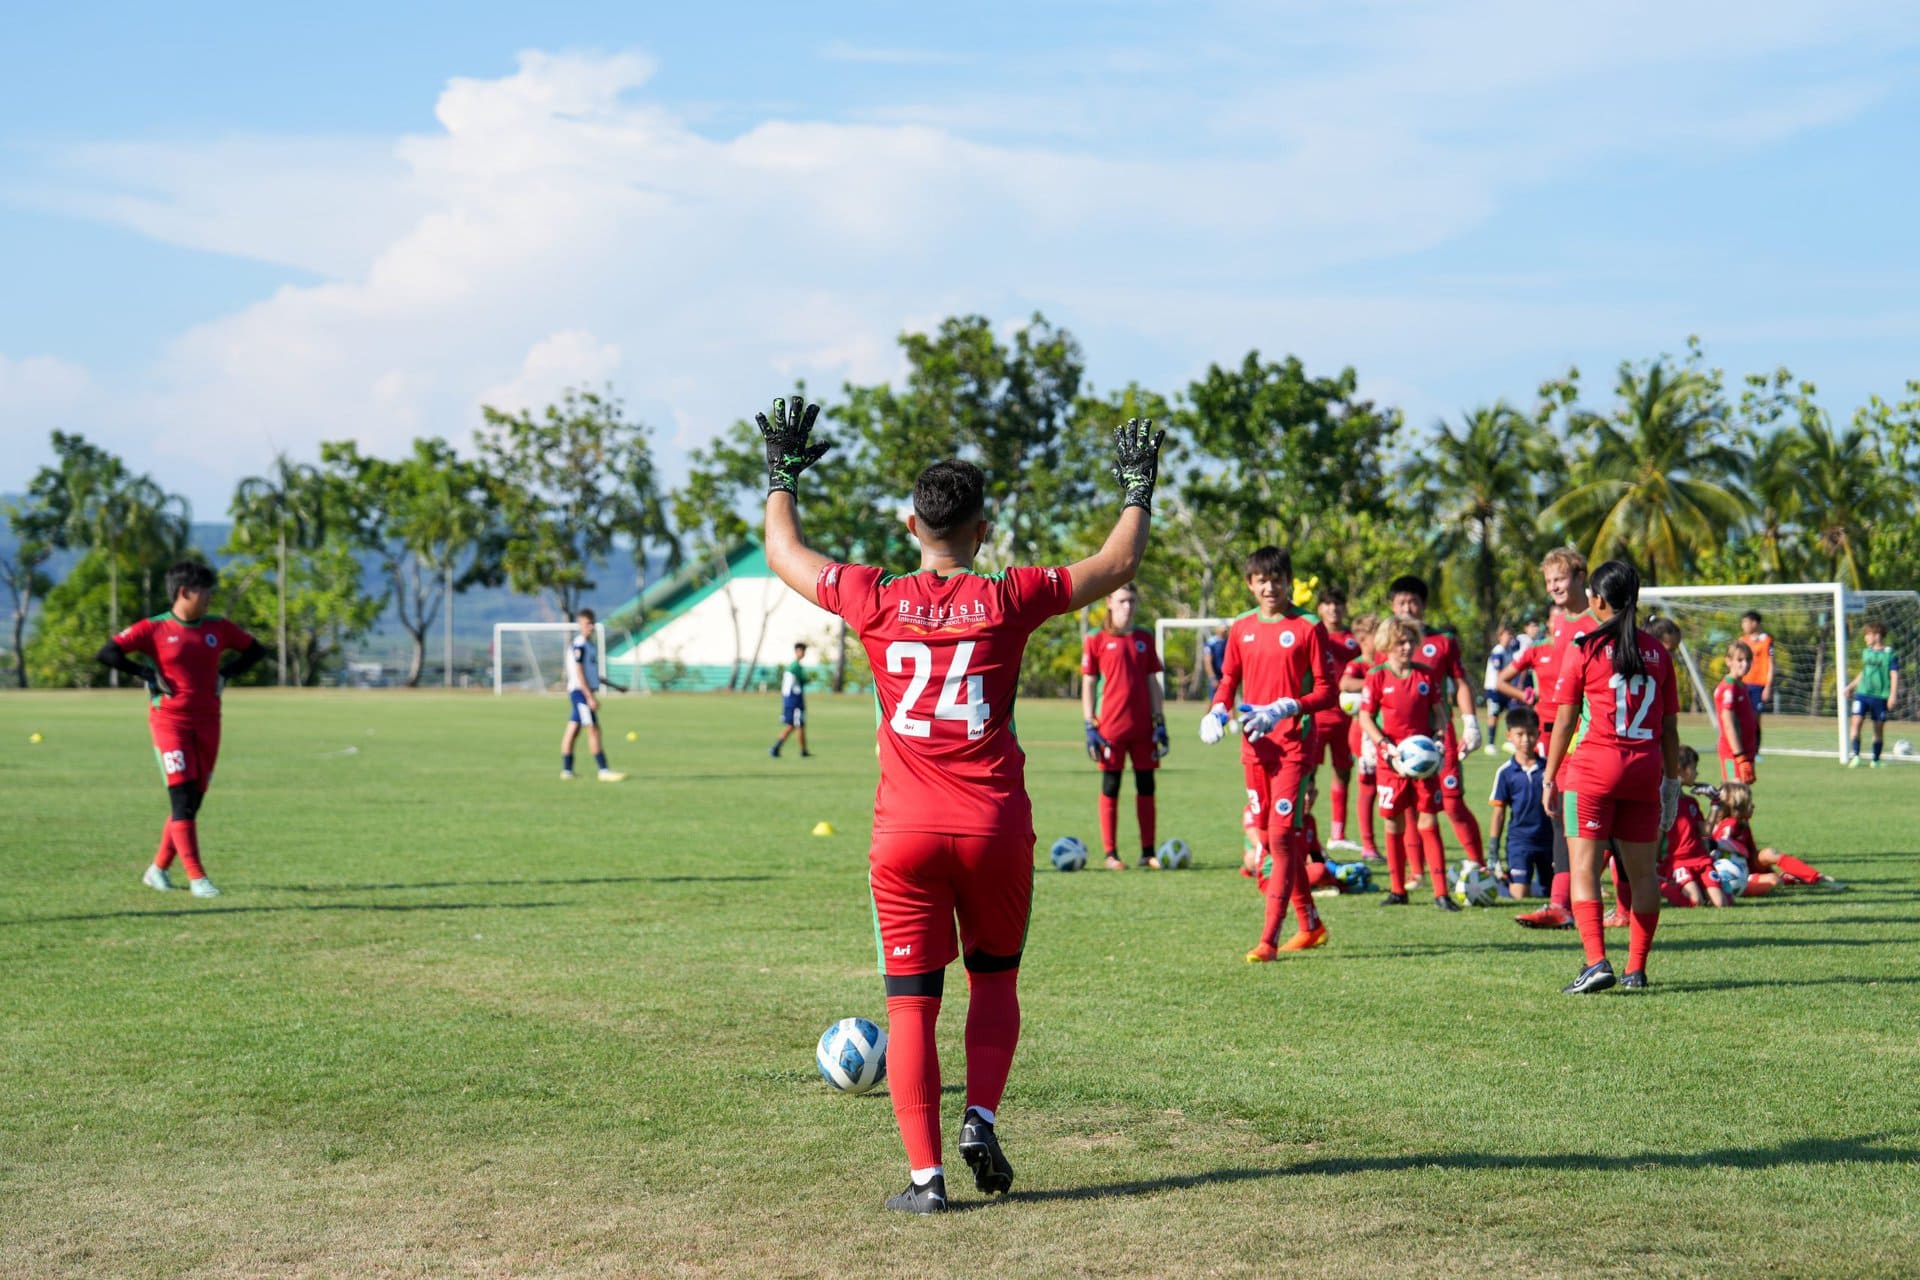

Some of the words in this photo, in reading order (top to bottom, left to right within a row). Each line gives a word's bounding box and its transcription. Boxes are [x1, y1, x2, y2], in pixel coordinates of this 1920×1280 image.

[899, 599, 985, 619] British
[885, 641, 990, 740] 24
[1608, 673, 1656, 739] 12
[893, 944, 911, 956] Ari
